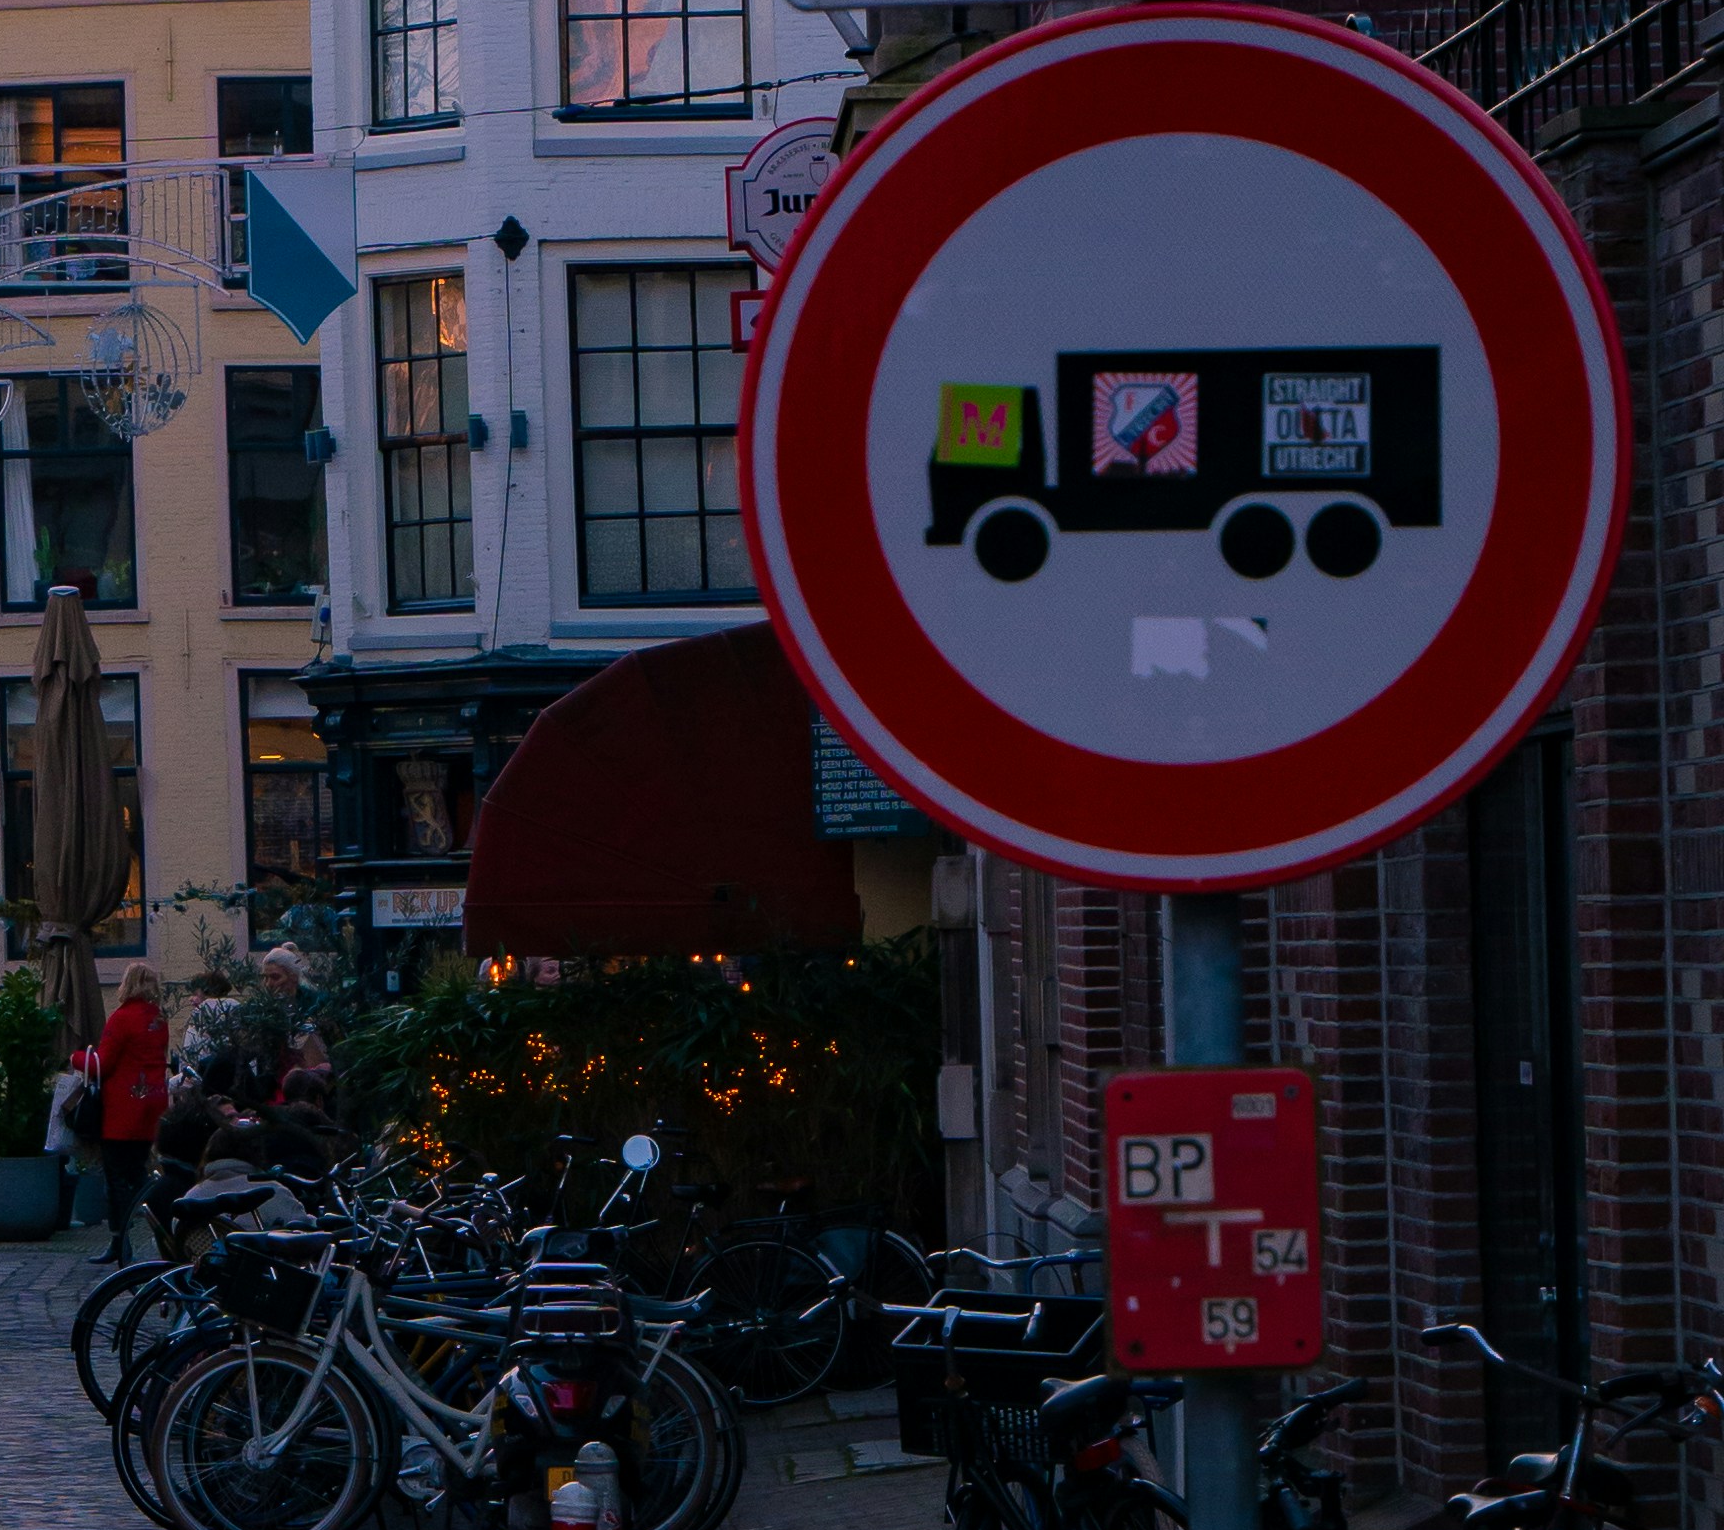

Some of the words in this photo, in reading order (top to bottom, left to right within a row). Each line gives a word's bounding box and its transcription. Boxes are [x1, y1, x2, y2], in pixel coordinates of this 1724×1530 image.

[1272, 377, 1361, 402] STRAIGHT
[957, 401, 1008, 450] M
[1274, 446, 1357, 471] UTRECHT
[436, 890, 460, 913] UP
[1125, 1137, 1206, 1199] BP
[1255, 1231, 1306, 1272] 54
[1206, 1299, 1256, 1340] 59
